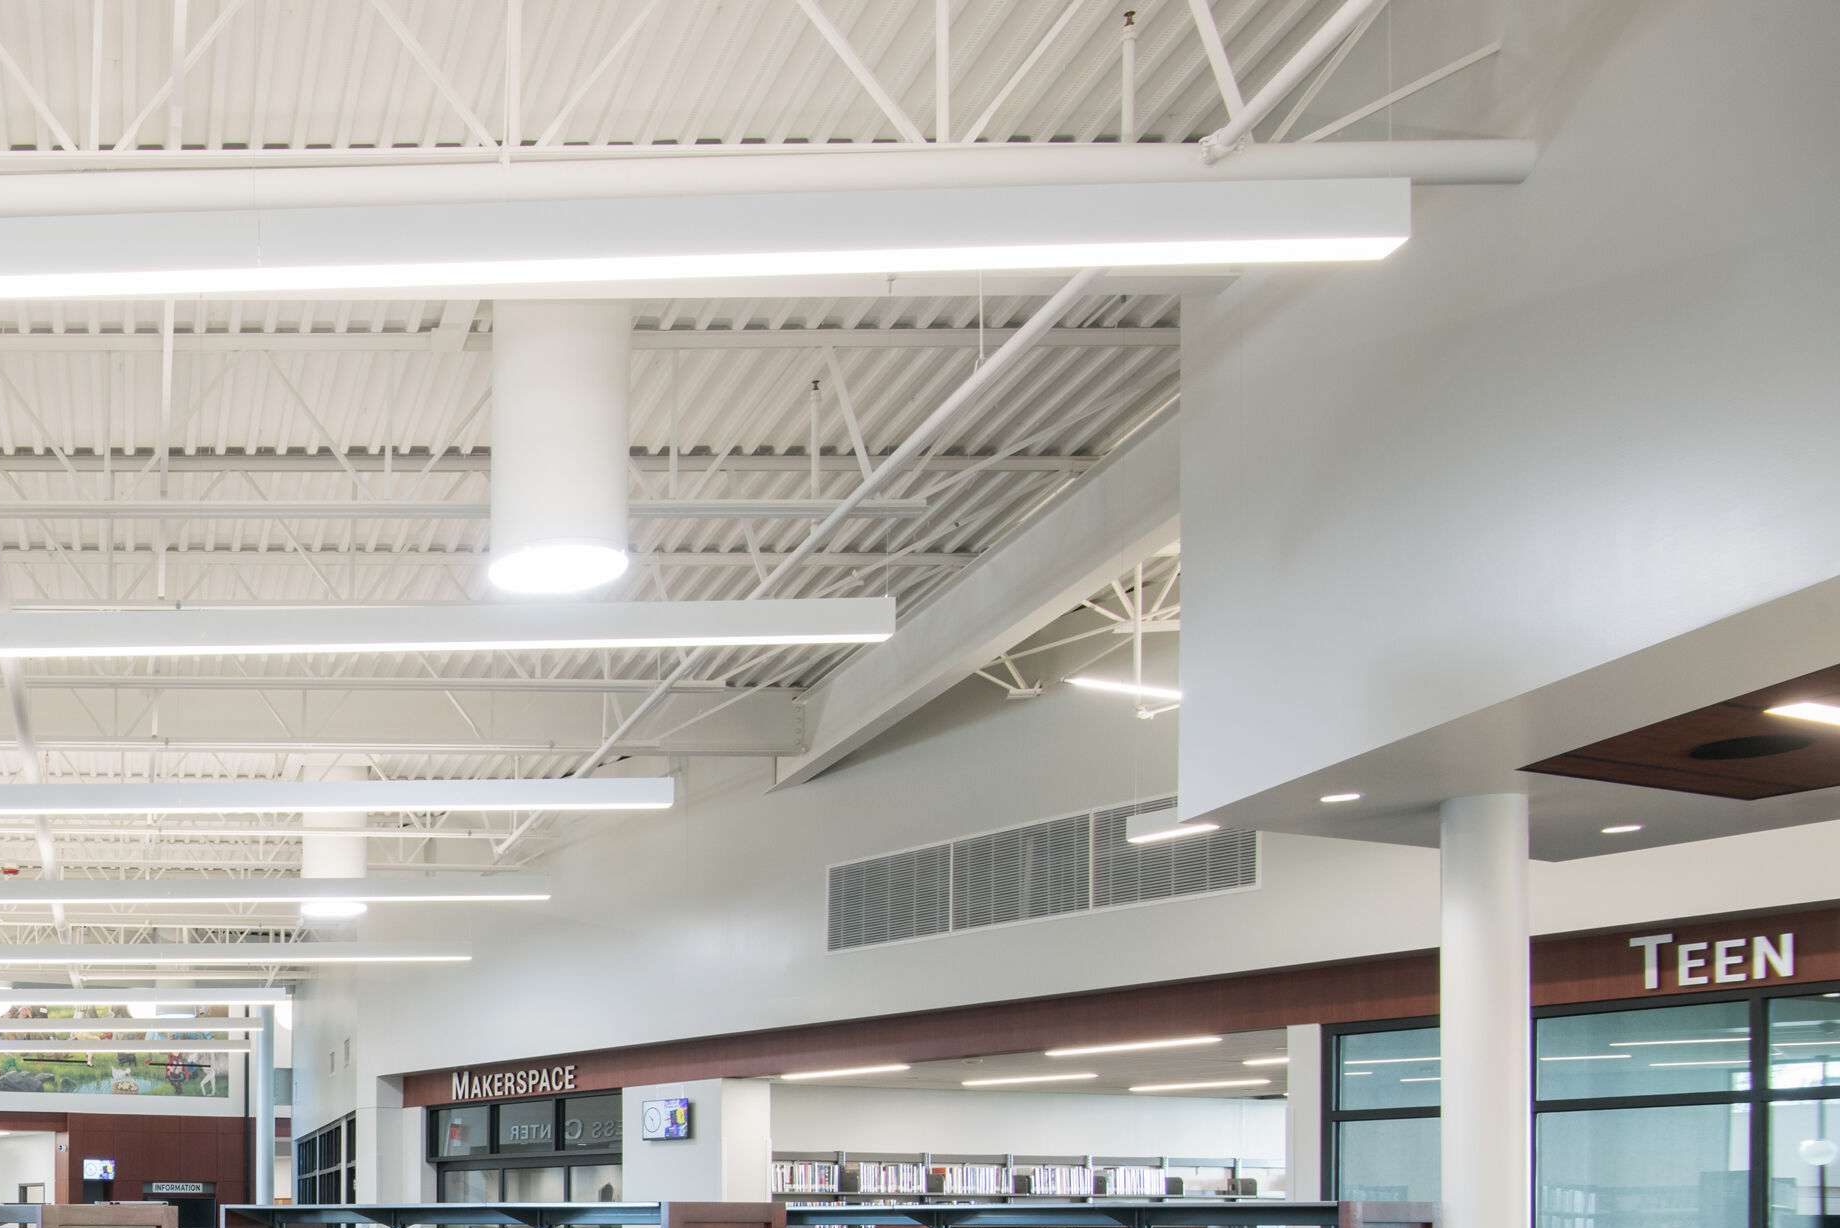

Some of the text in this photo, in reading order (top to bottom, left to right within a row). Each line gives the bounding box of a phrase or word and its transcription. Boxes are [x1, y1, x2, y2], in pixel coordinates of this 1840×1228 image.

[1629, 932, 1796, 990] TEEN
[451, 1065, 576, 1100] MAKERSPACE
[154, 1184, 201, 1192] INFORMATION
